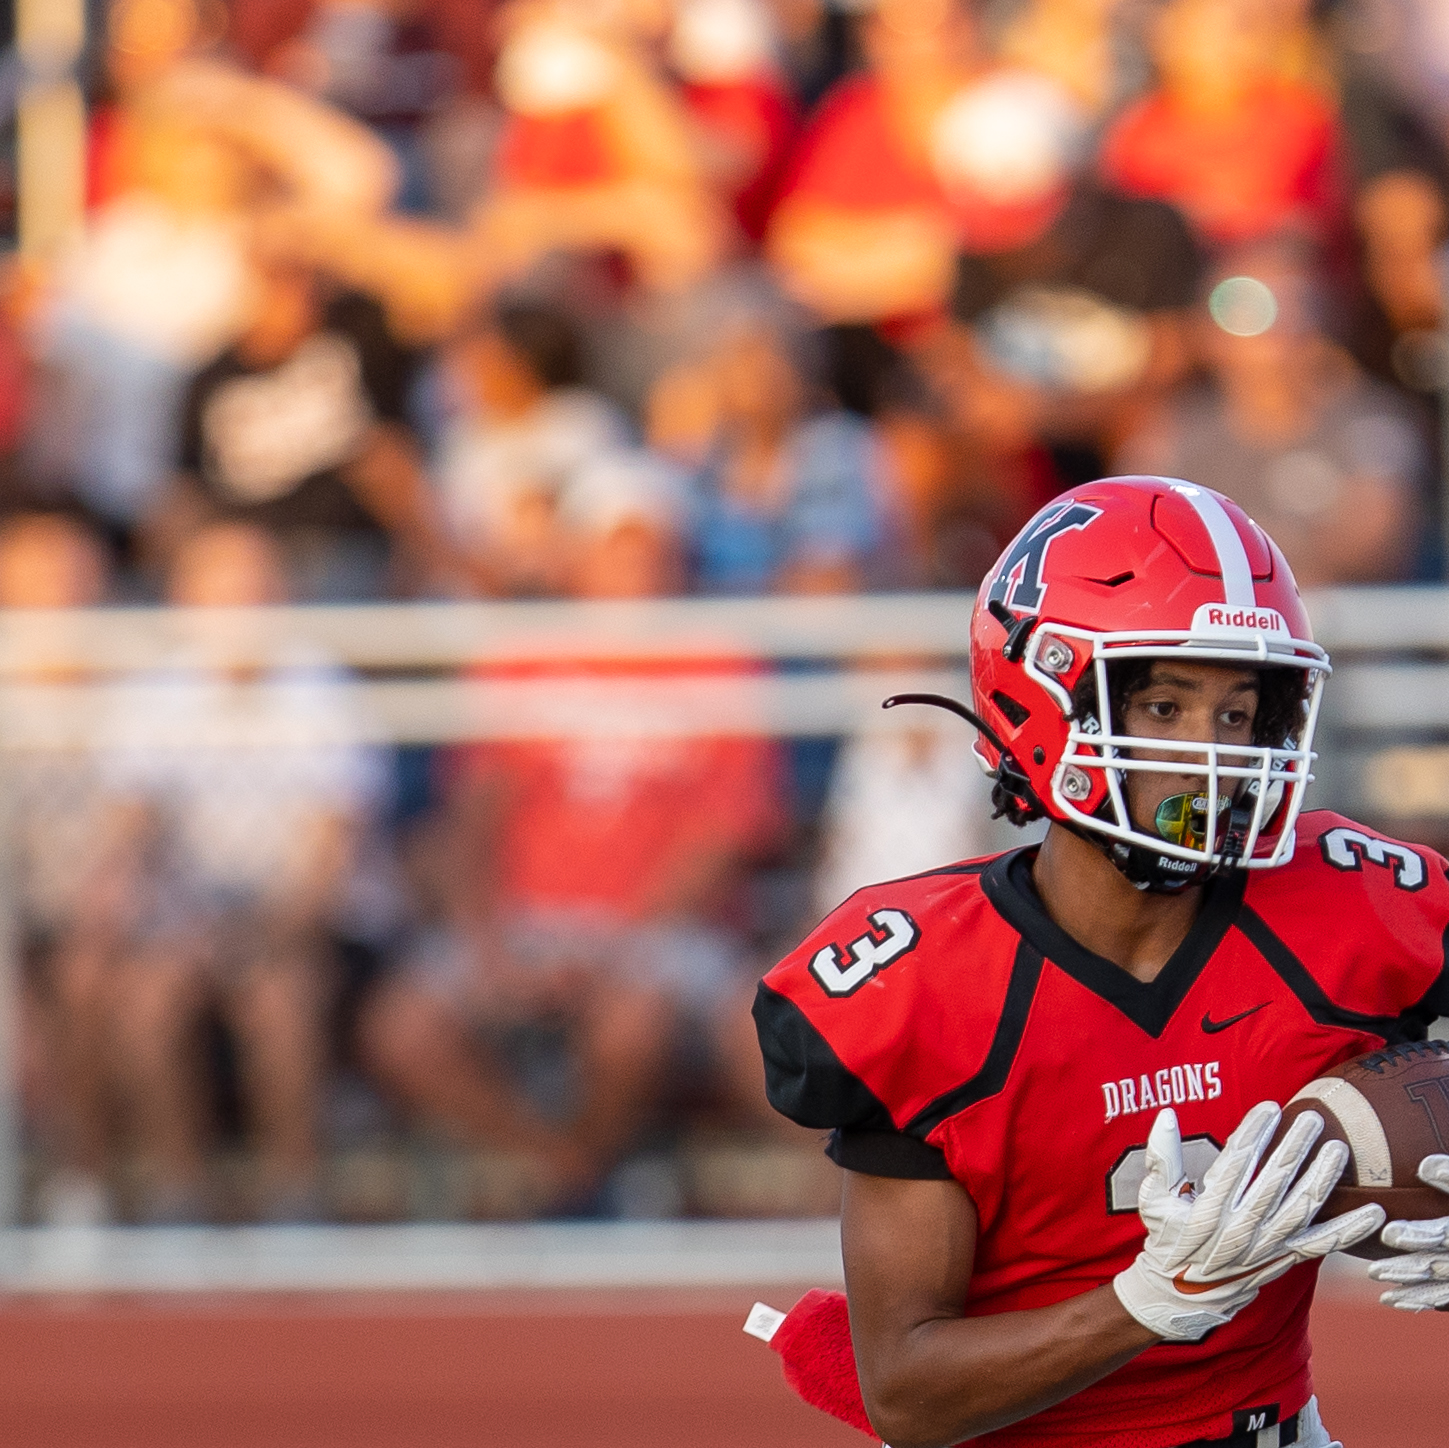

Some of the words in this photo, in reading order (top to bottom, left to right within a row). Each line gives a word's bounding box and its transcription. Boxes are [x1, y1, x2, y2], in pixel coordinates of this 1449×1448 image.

[1208, 607, 1281, 631] Riddell
[1158, 856, 1197, 872] Riddell
[1318, 827, 1429, 893] 3
[808, 908, 922, 998] 3
[1101, 1060, 1222, 1119] DRAGONS
[1246, 1411, 1266, 1432] M
